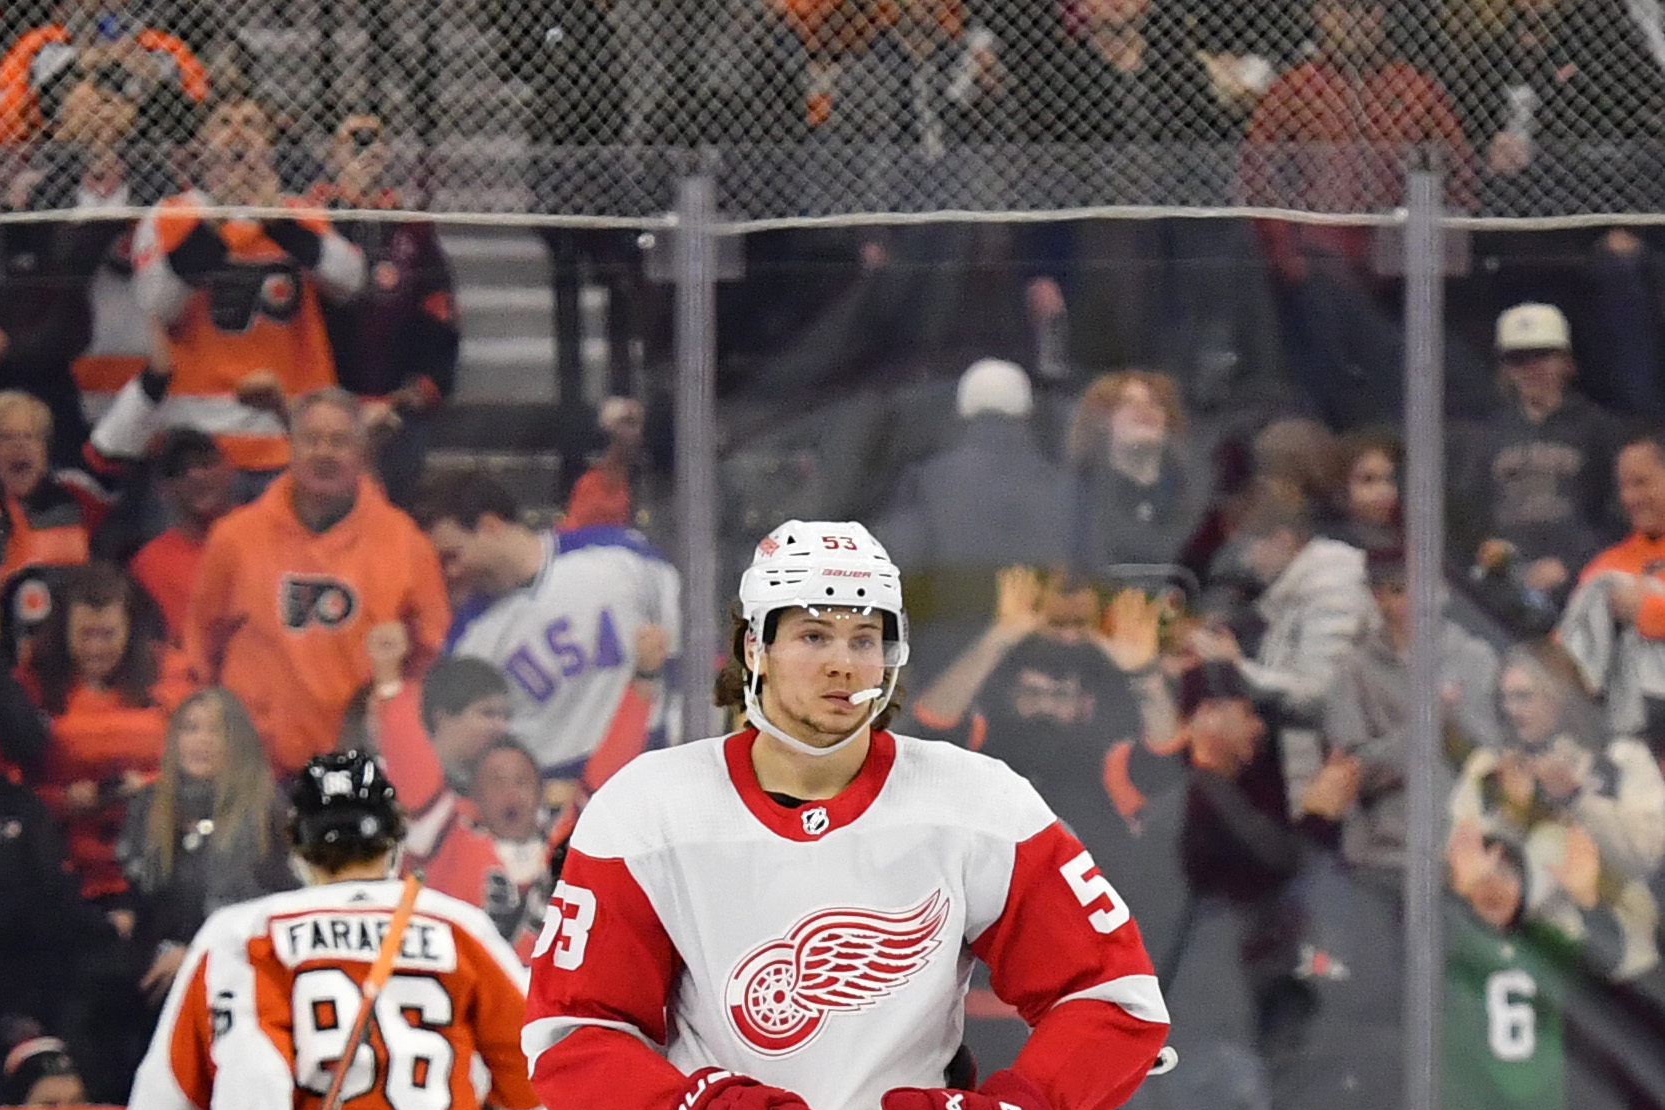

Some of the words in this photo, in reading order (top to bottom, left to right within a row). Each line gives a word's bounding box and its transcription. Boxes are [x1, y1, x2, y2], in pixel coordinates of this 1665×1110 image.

[821, 536, 857, 551] 53
[821, 568, 872, 578] BAUER
[505, 604, 624, 703] USA
[1485, 968, 1537, 1062] 6
